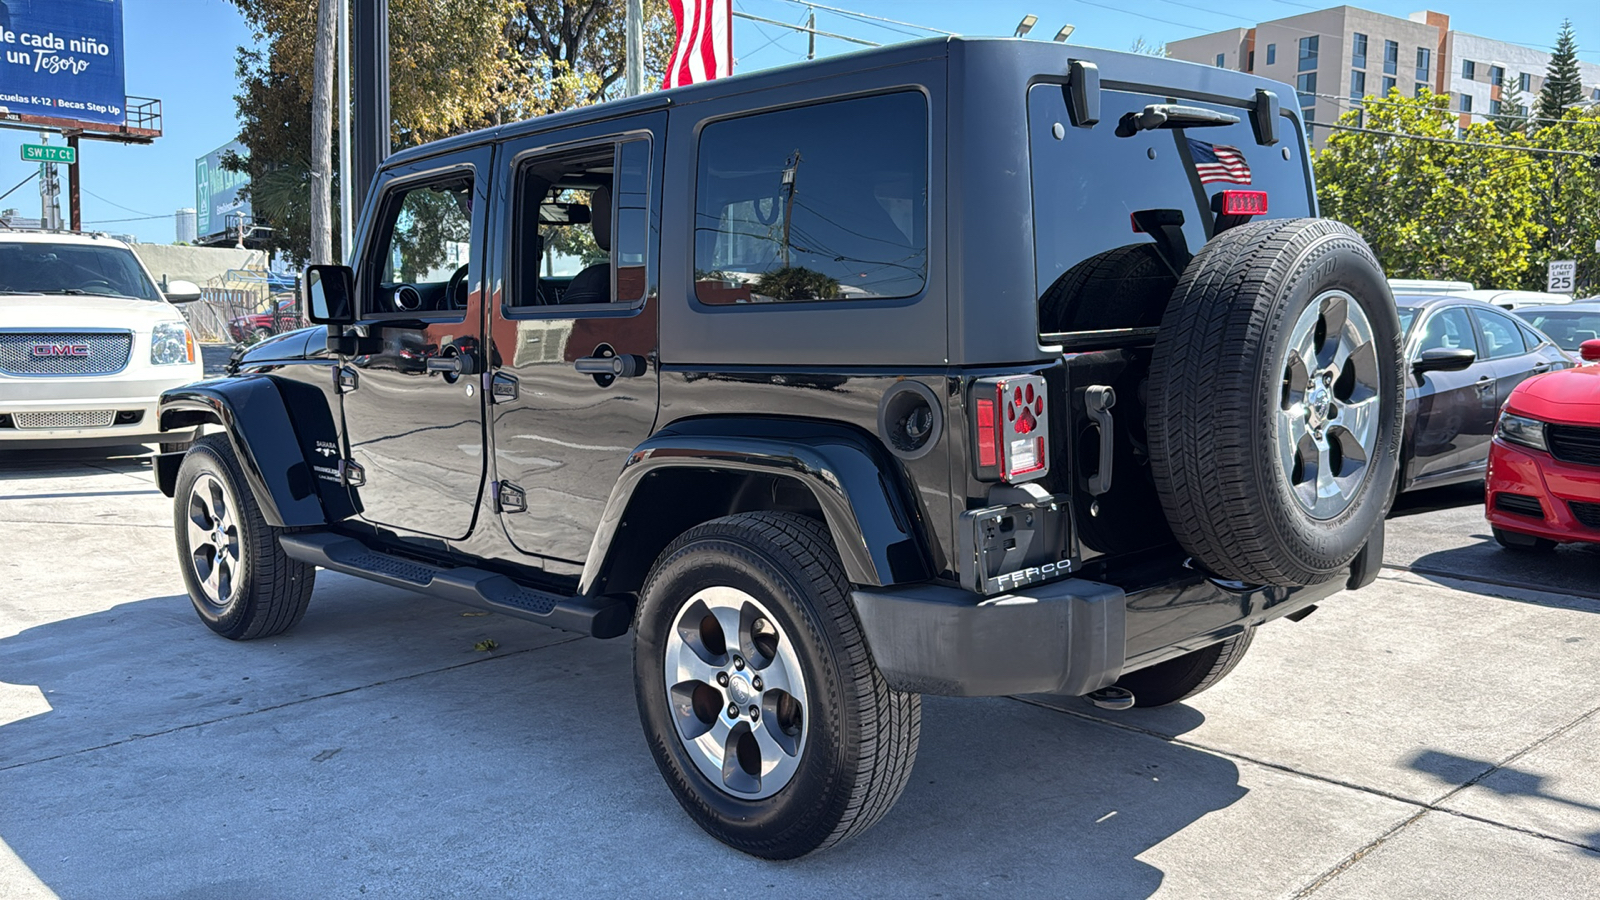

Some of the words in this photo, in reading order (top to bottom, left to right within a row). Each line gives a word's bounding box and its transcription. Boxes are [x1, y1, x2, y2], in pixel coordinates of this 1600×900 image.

[20, 32, 65, 50] cada
[70, 36, 108, 56] niño
[6, 50, 31, 66] un
[33, 49, 90, 75] Tesoro
[31, 95, 52, 106] K-12
[58, 98, 85, 110] Becas
[86, 102, 107, 114] Step
[107, 105, 121, 116] Up
[27, 147, 43, 158] SW
[45, 148, 56, 159] 17
[58, 150, 71, 160] Ct
[1550, 277, 1571, 288] 25
[33, 344, 91, 356] GMC
[997, 560, 1071, 585] FERCO
